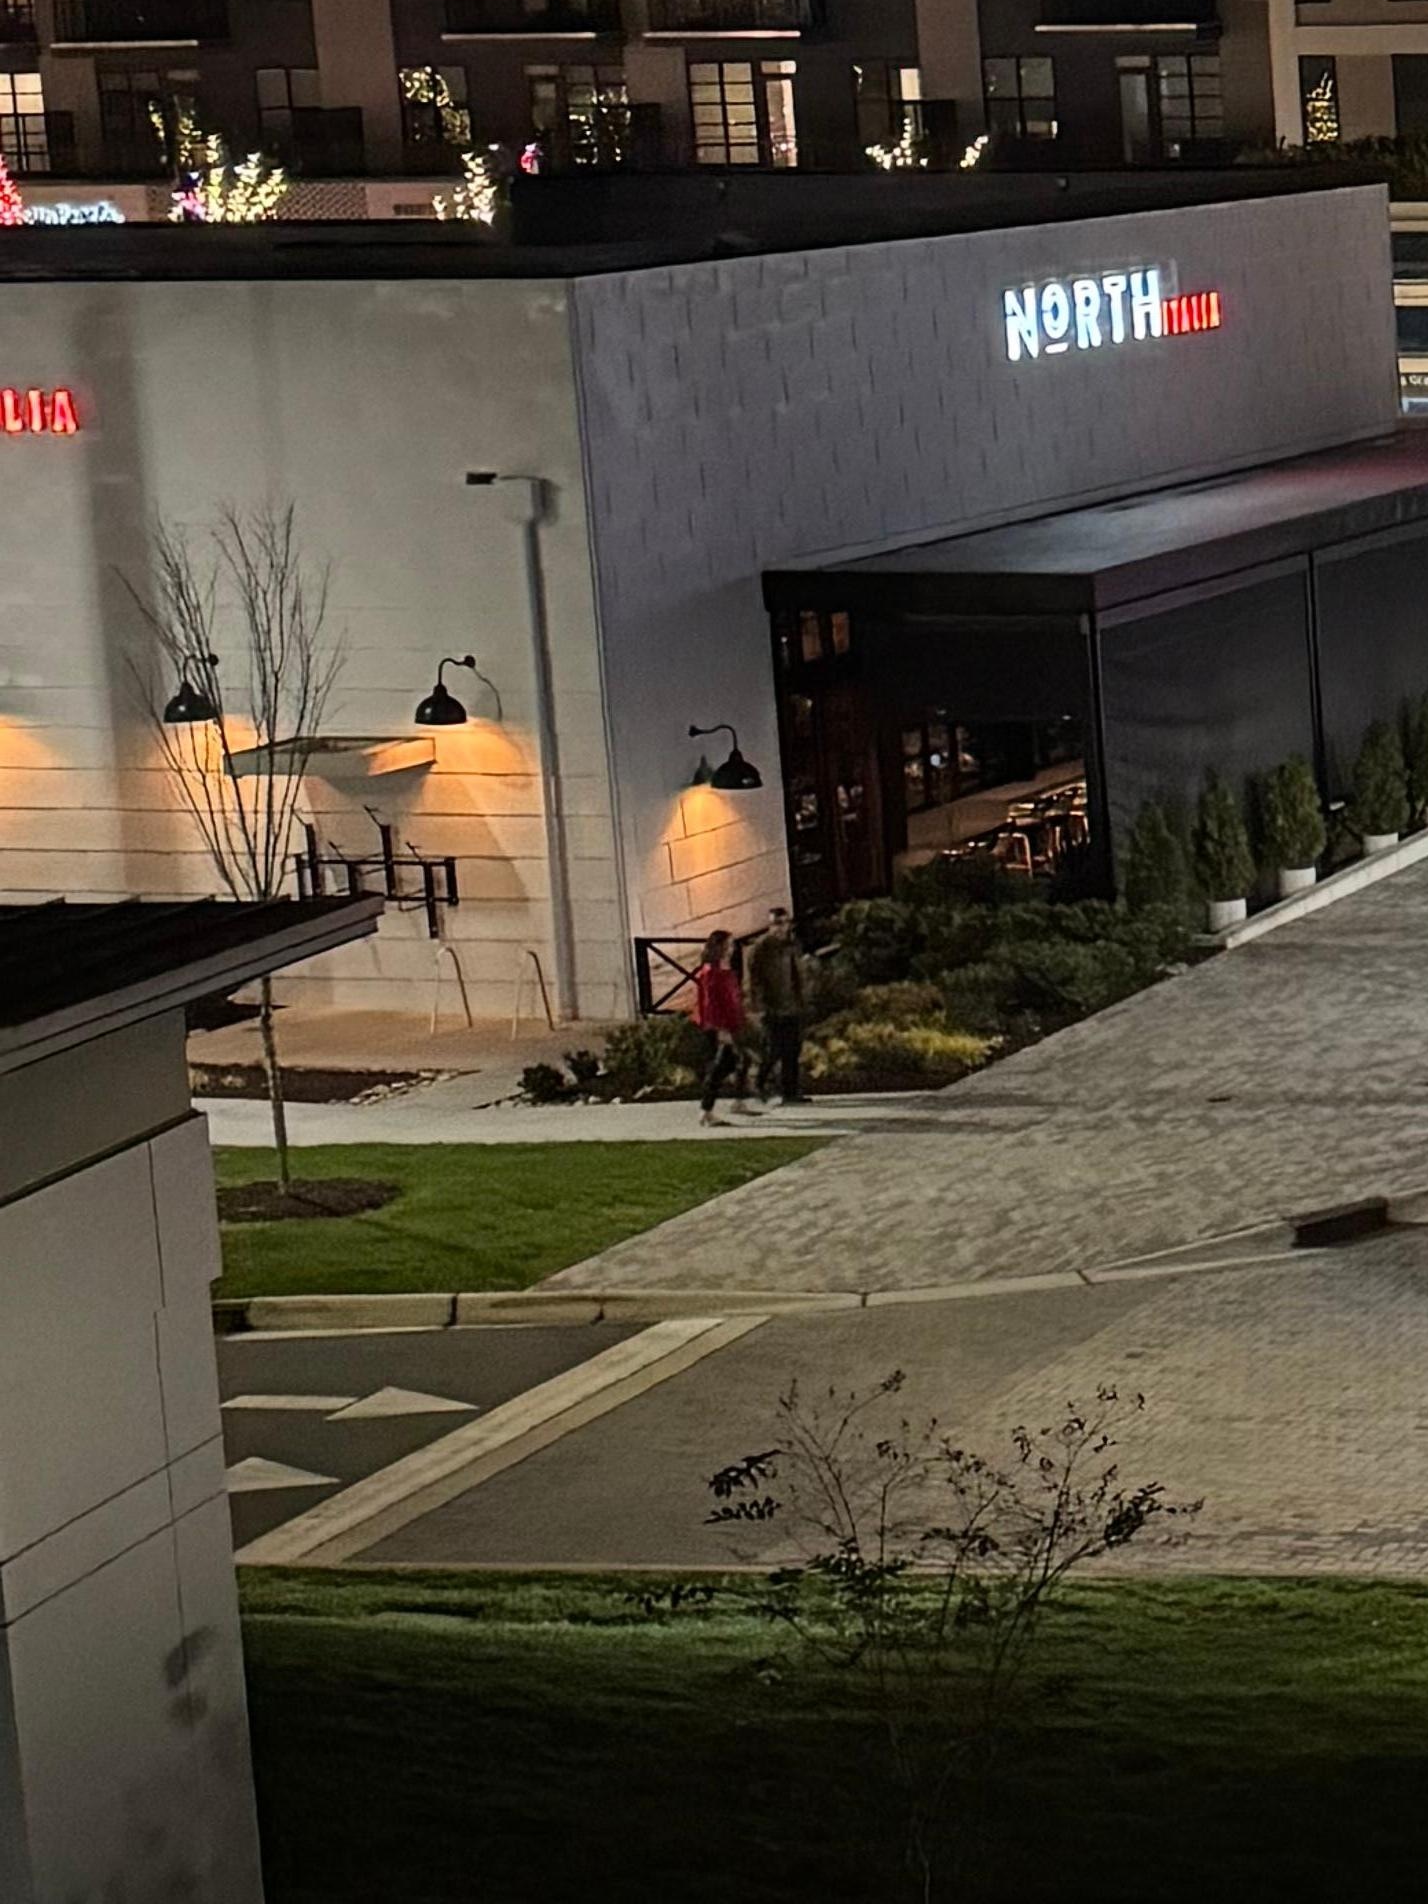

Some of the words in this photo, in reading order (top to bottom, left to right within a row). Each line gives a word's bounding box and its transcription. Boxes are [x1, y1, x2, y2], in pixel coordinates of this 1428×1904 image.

[1004, 269, 1162, 361] NORTH
[1162, 291, 1221, 336] ITALIA
[0, 389, 78, 434] LIA
